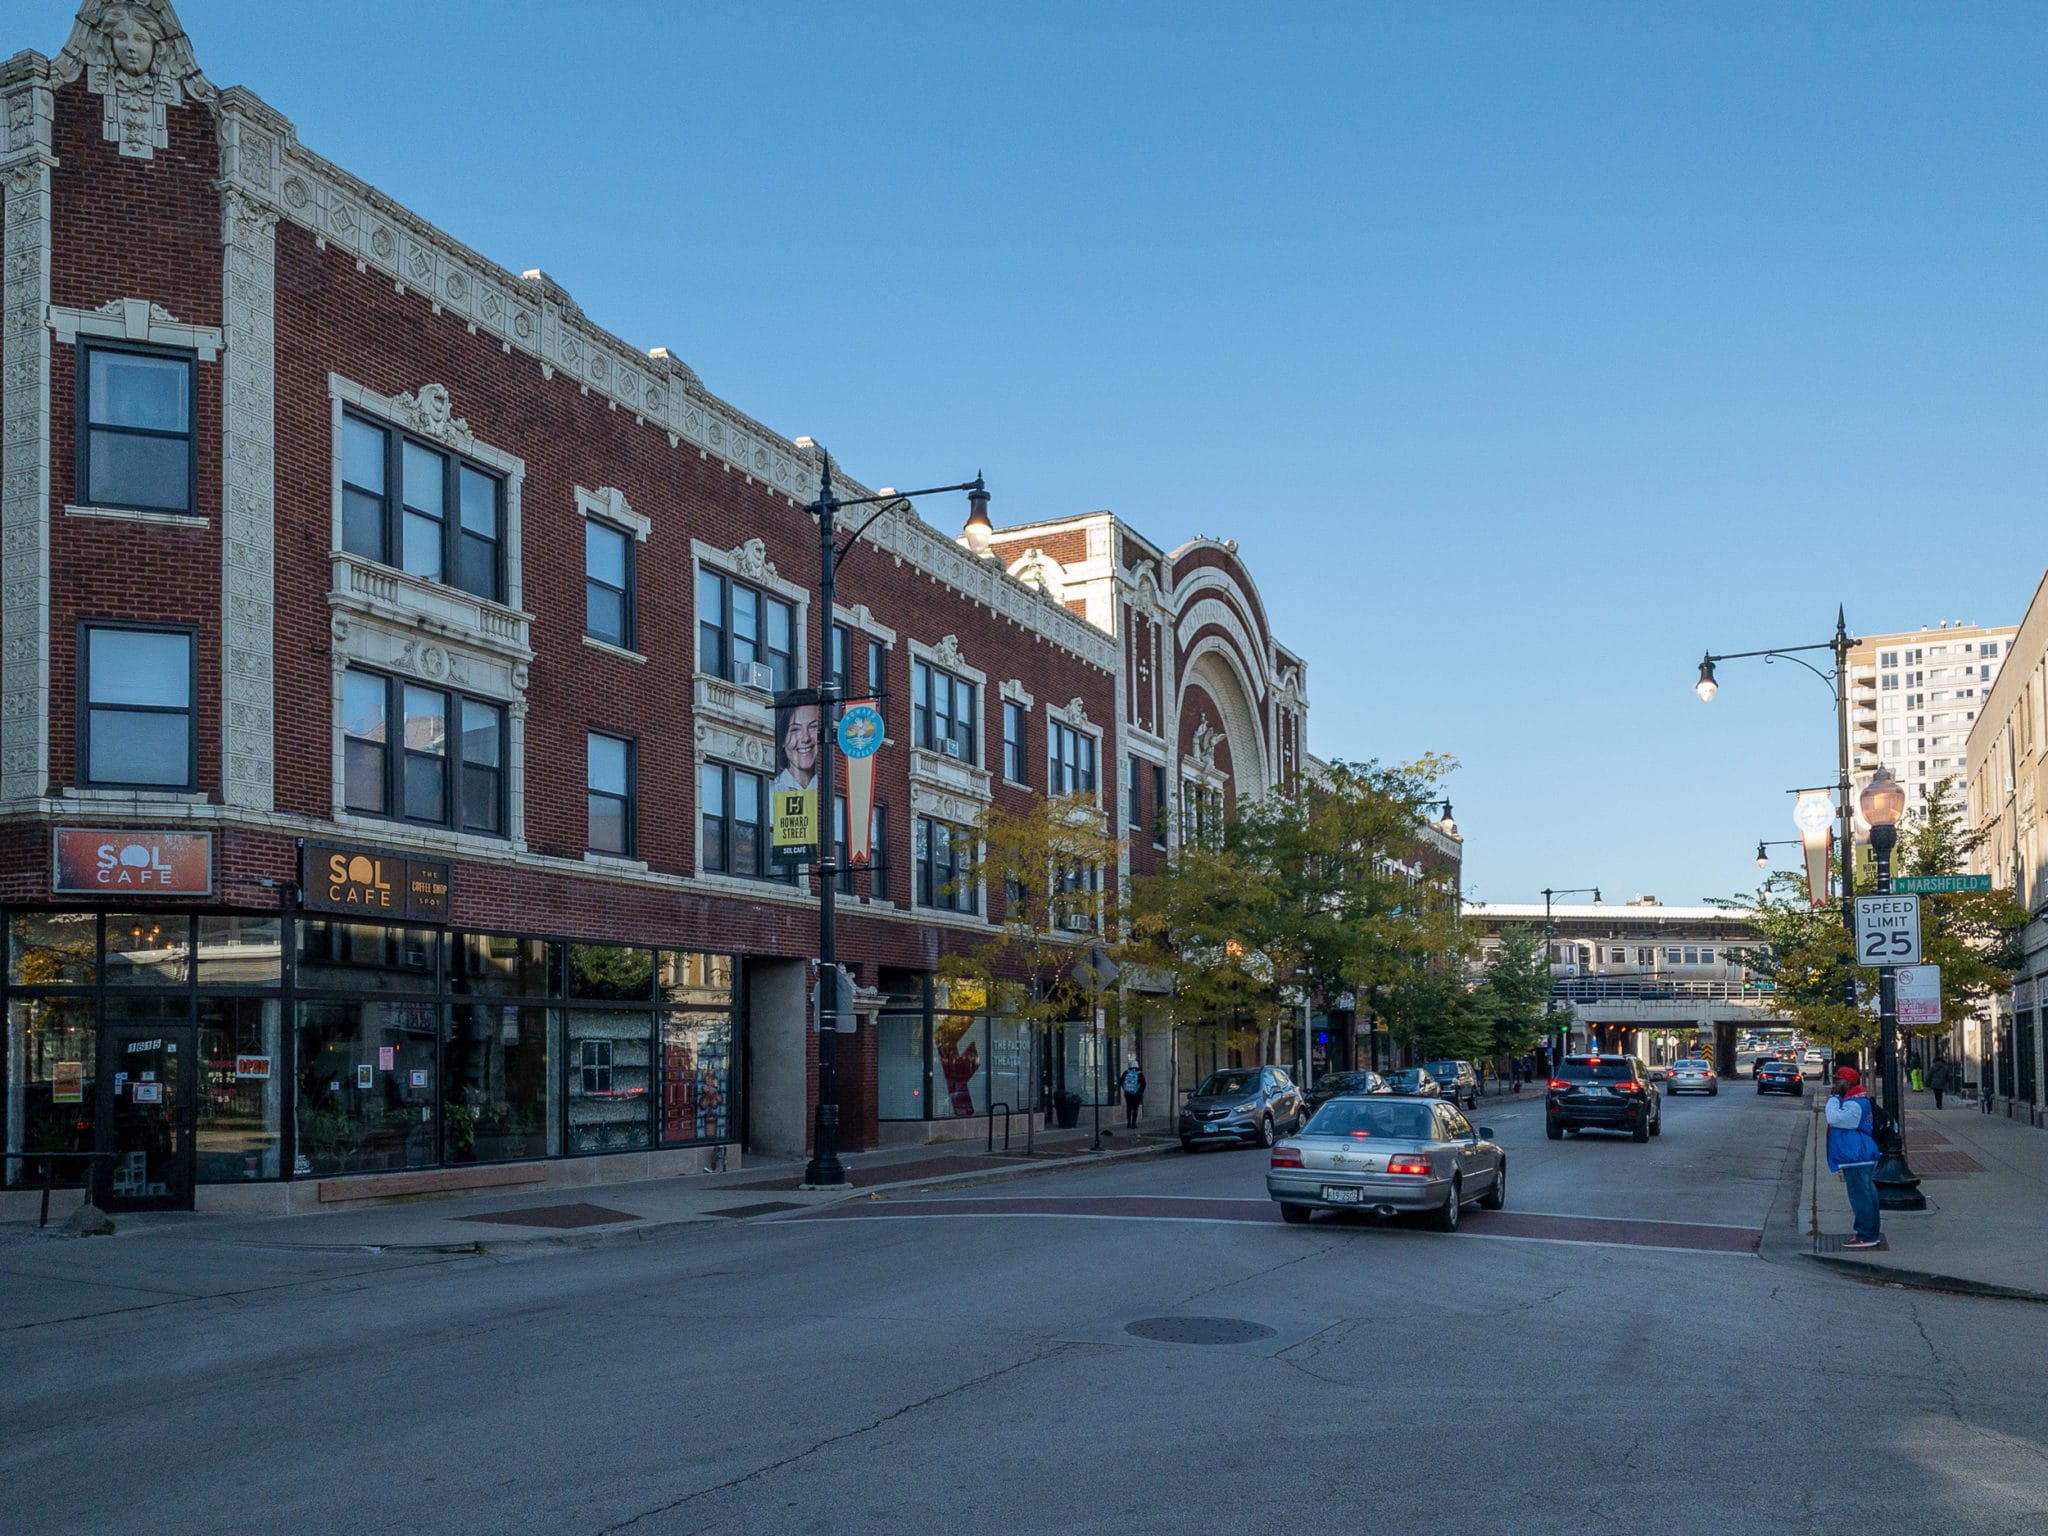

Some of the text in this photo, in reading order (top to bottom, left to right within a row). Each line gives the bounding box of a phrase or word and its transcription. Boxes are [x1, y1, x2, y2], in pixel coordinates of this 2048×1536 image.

[780, 816, 809, 828] HOWARD
[782, 828, 807, 839] STREET
[96, 844, 172, 870] SOL
[96, 870, 172, 884] CAFE
[329, 854, 391, 889] SOL
[421, 870, 438, 879] THE
[411, 880, 448, 895] COFFEE SHOP
[1907, 877, 1978, 891] MARSHFIELD
[329, 885, 391, 907] CAFE
[419, 898, 440, 906] SPOT
[1862, 902, 1914, 914] SPEED
[1867, 916, 1908, 928] LIMIT
[1865, 931, 1912, 957] 25
[128, 1039, 161, 1053] 1615
[993, 1040, 1007, 1050] THE
[239, 1059, 269, 1074] OPEN
